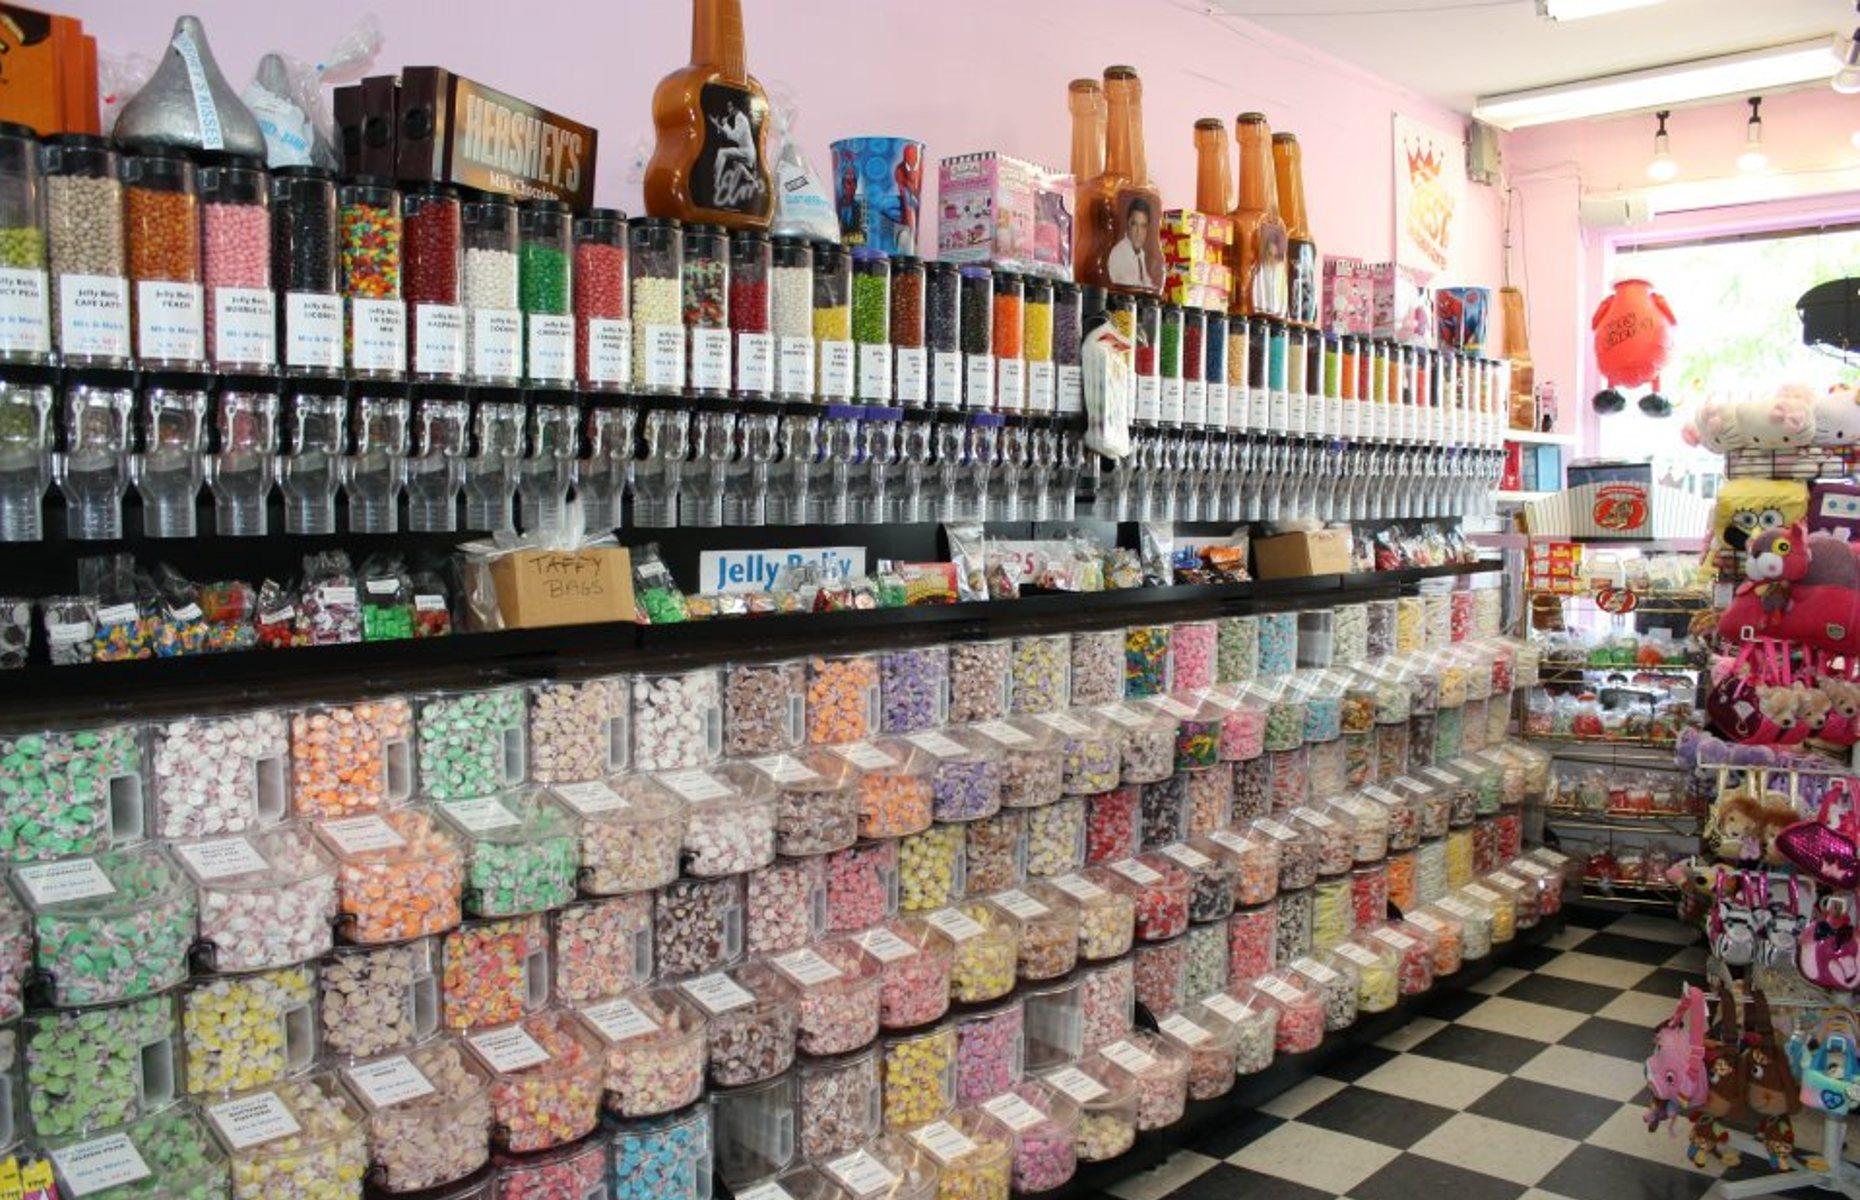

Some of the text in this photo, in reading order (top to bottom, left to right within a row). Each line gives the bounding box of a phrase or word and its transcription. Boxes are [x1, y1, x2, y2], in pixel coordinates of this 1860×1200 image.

[464, 94, 582, 192] HERSHEY'S
[488, 170, 512, 189] Milk
[527, 554, 603, 576] TAFFY
[717, 552, 851, 592] Jelly Blly
[541, 579, 604, 599] BAGS
